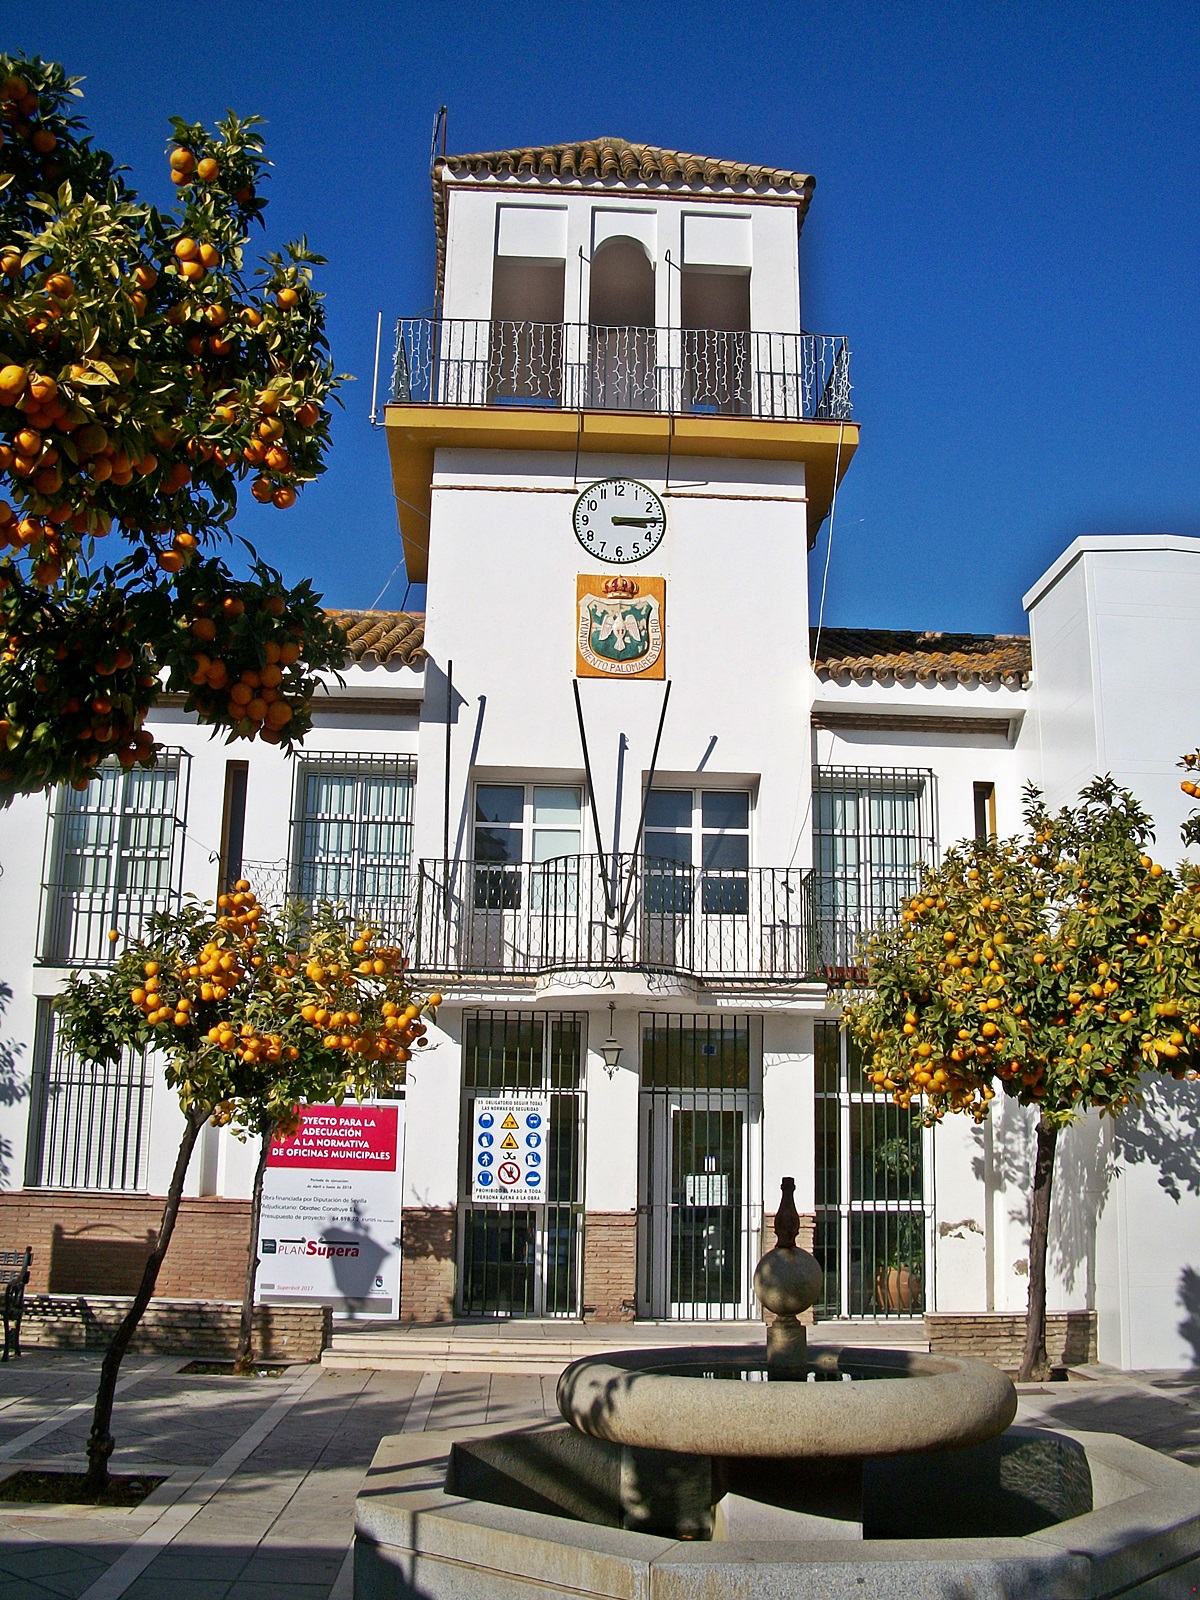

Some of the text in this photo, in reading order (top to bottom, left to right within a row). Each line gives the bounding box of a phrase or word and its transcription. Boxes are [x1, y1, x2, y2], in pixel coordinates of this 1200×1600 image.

[600, 488, 607, 500] 11
[614, 485, 625, 497] 12
[587, 500, 598, 511] 10
[645, 501, 653, 513] 2
[581, 514, 590, 526] 9
[586, 530, 595, 541] 8
[644, 531, 652, 543] 4
[599, 541, 607, 553] 7
[615, 546, 624, 557] 6
[632, 542, 640, 554] 5
[579, 616, 609, 671] AYUNTAMIENTO
[609, 652, 657, 673] PALOMARES
[651, 636, 661, 652] DEL
[302, 1117, 376, 1127] OYECTO PARA LA
[302, 1127, 362, 1137] ADECUACIÓN
[294, 1138, 370, 1149] A LA NORMATIVA
[272, 1148, 391, 1161] DE OFICINAS MUNICIPALES
[278, 1241, 360, 1259] PLAN Supera
